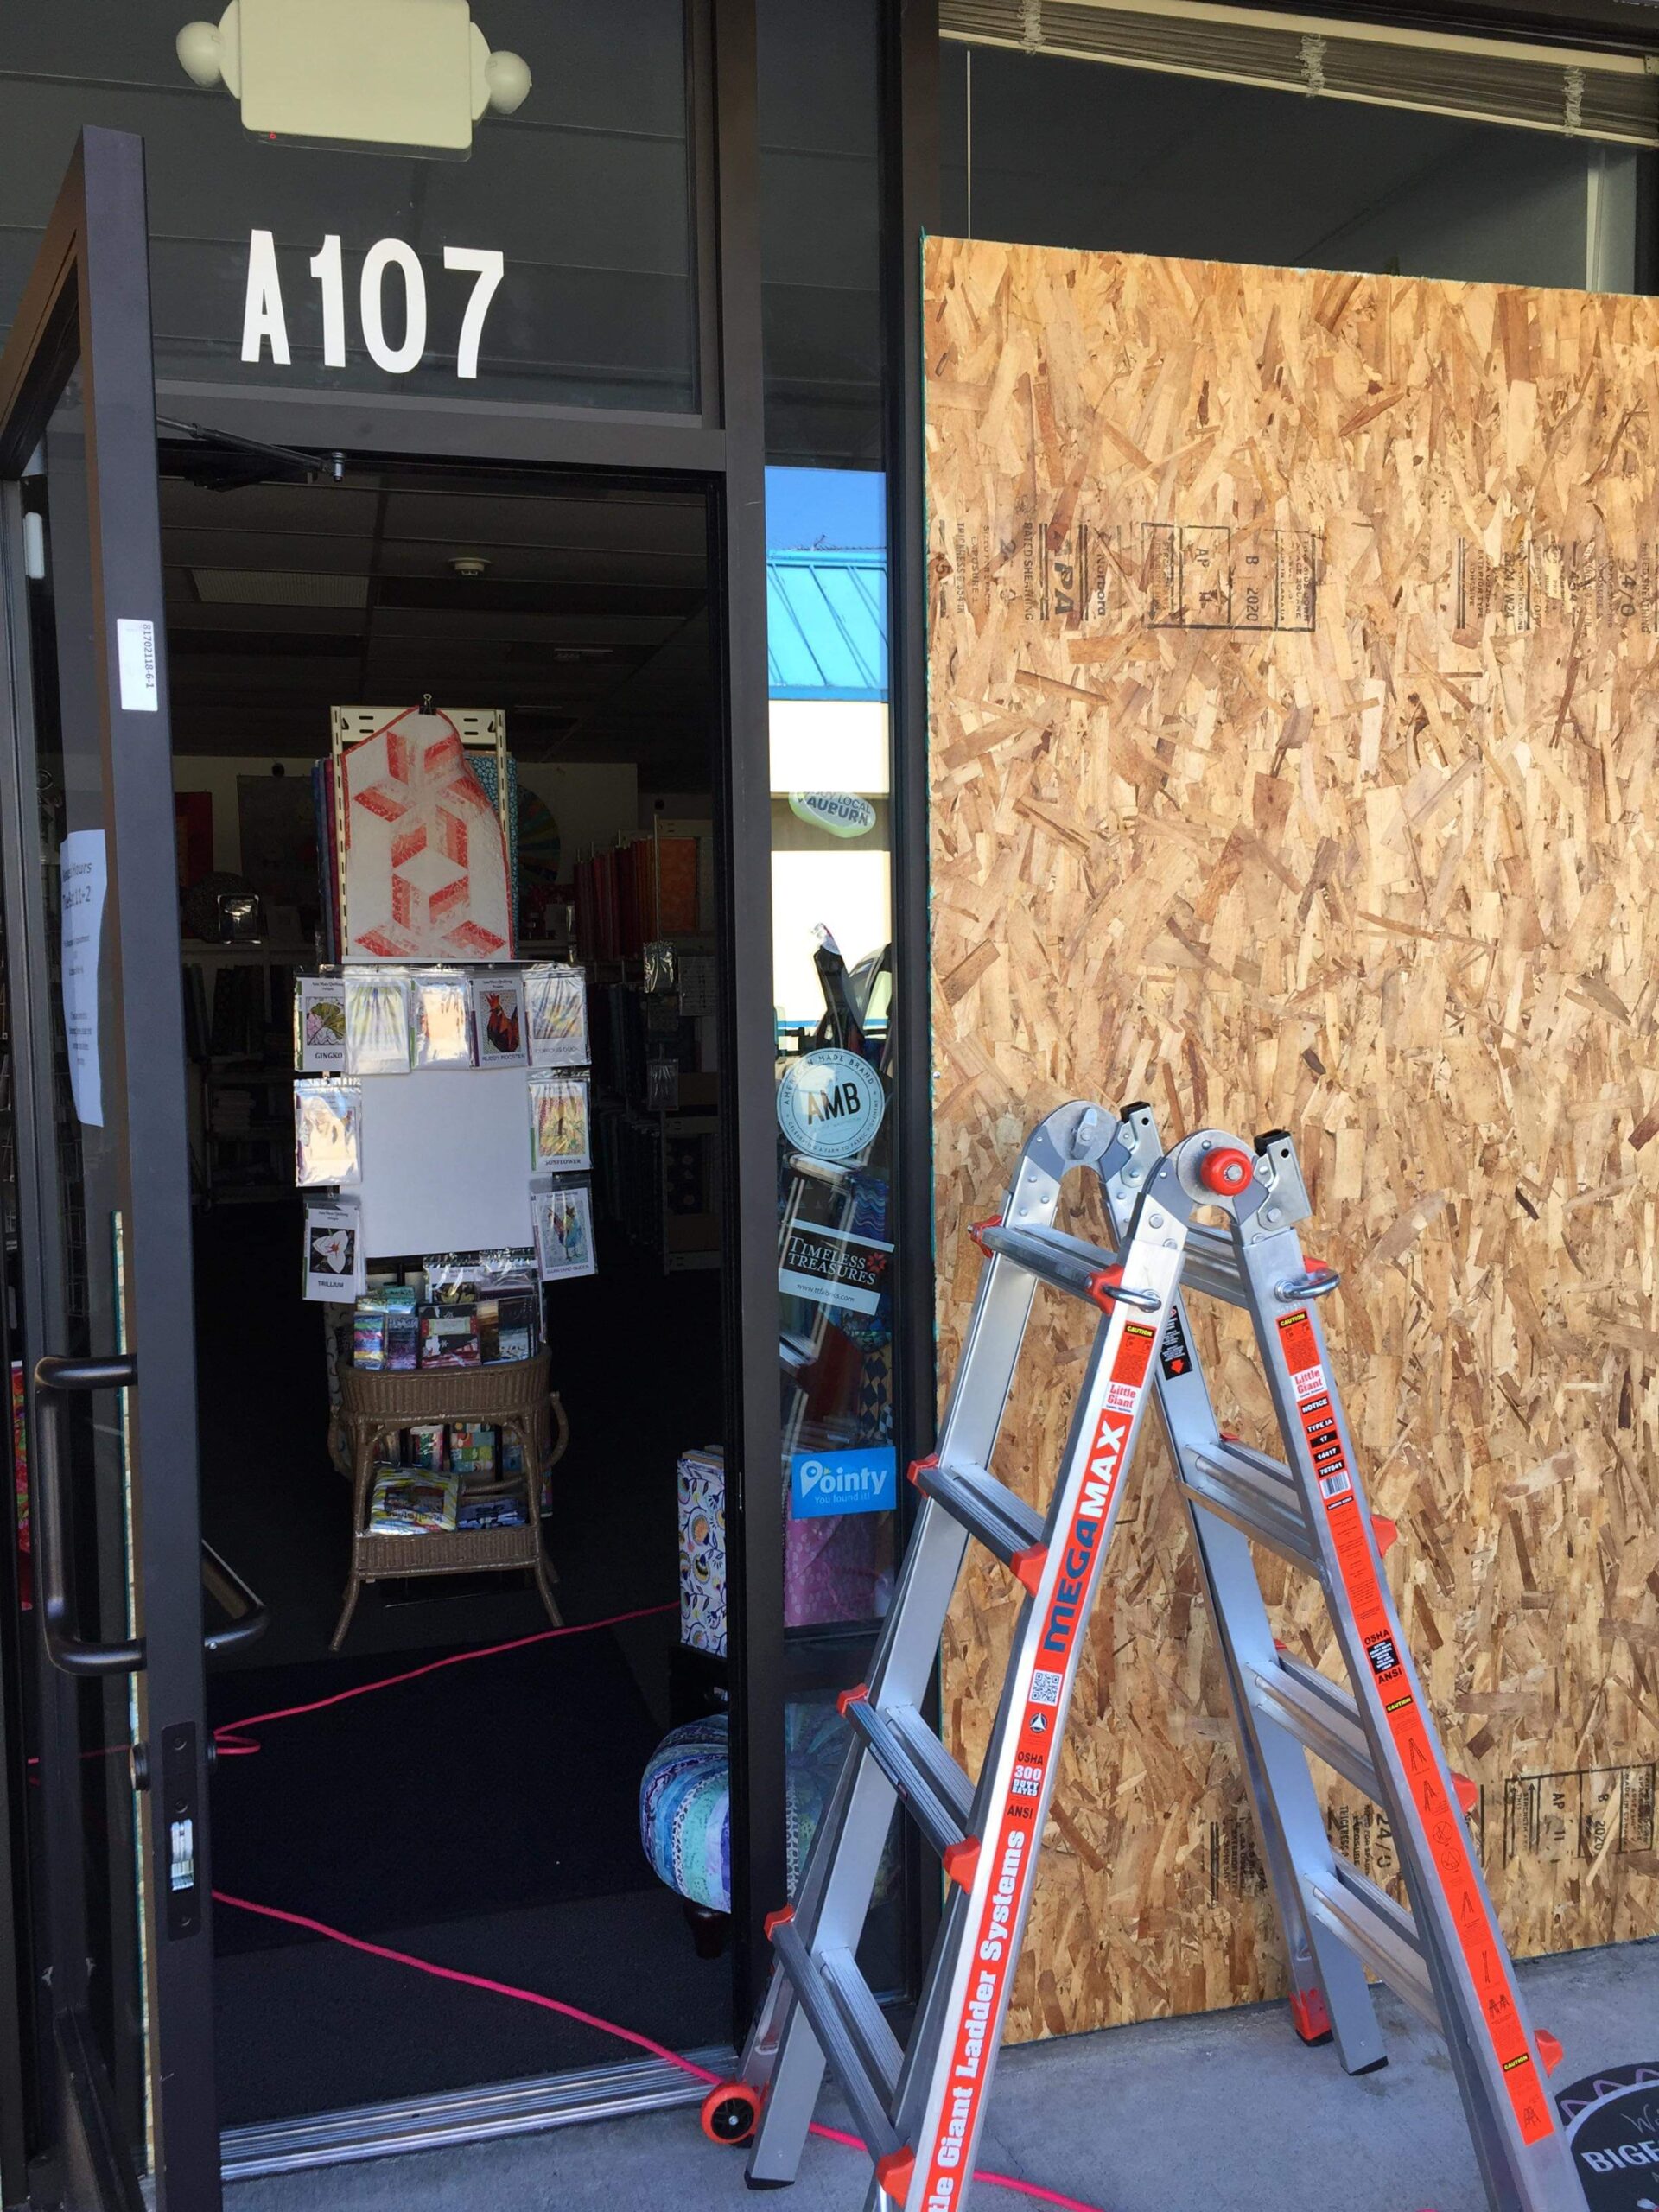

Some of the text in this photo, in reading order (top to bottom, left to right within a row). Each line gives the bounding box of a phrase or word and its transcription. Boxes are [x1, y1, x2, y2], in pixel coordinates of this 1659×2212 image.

[240, 229, 504, 378] A107
[1195, 547, 1211, 569] AP
[1246, 587, 1260, 622] 2020
[143, 623, 155, 689] 81702118-6-1
[806, 795, 869, 827] AUBURN
[837, 794, 872, 815] LOCAL
[315, 1052, 343, 1060] GINGKO
[818, 1053, 845, 1063] MADE
[849, 1058, 874, 1085] BRAND
[807, 1081, 861, 1126] AMB
[787, 1253, 876, 1286] TREASURES
[317, 1281, 345, 1289] TRILLIUM
[1280, 1313, 1306, 1326] CAUTION
[1126, 1325, 1154, 1338] CAUTION
[1294, 1370, 1321, 1385] Little
[1109, 1384, 1136, 1399] Little
[1297, 1379, 1324, 1395] Giant
[1107, 1394, 1135, 1408] Giant
[1301, 1398, 1328, 1414] NOTICE
[1307, 1421, 1325, 1433] TYPE
[1317, 1447, 1337, 1460] 14417
[800, 1460, 887, 1498] Pointy
[814, 1496, 830, 1505] You
[832, 1492, 859, 1503] found
[1363, 1629, 1390, 1645] OSHA
[1378, 1667, 1402, 1685] ANSI
[1386, 1697, 1412, 1712] CAUTION
[1017, 1751, 1044, 1765] OSHA
[1014, 1764, 1042, 1781] 300
[1553, 1792, 1566, 1810] AP
[1007, 1804, 1034, 1820] ANSI
[1339, 1805, 1350, 1850] THICKNESS
[1594, 1793, 1610, 1851] B 2020
[1375, 1813, 1393, 1868] 24/0
[979, 1829, 1026, 1962] Systems
[955, 1971, 997, 2079] Ladder
[1503, 2055, 1529, 2070] CAUTION
[937, 2088, 974, 2168] Giant
